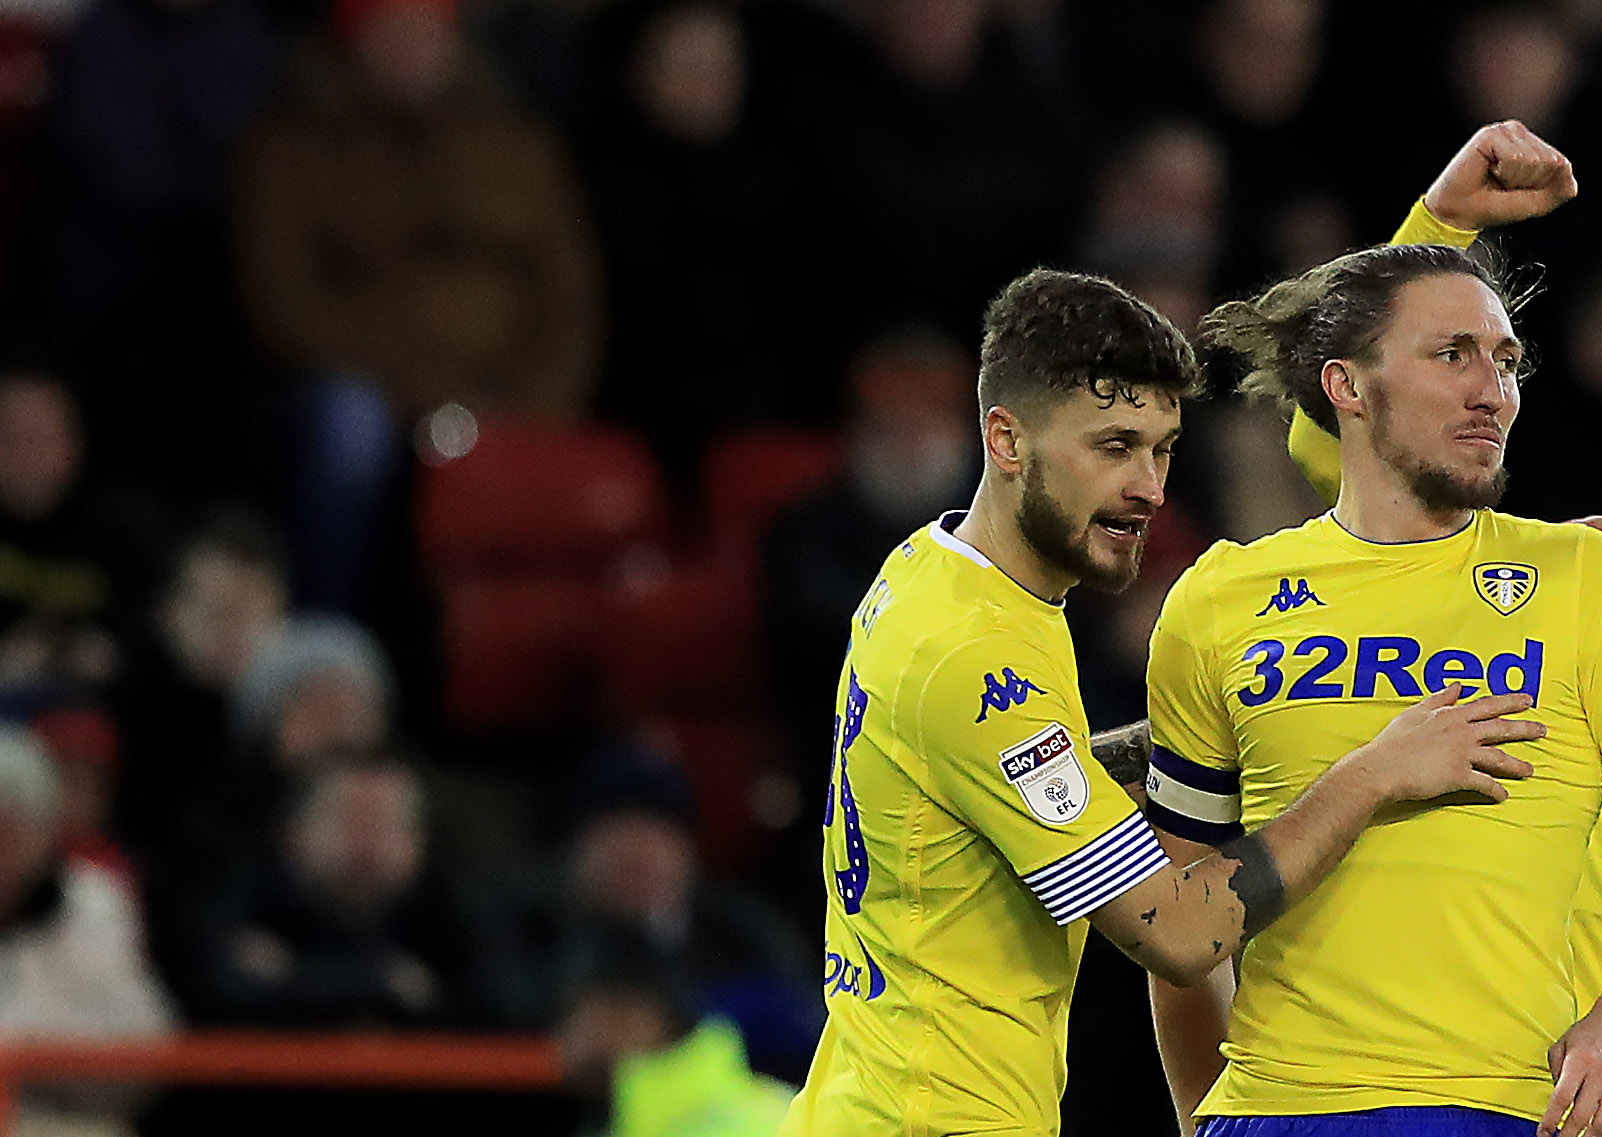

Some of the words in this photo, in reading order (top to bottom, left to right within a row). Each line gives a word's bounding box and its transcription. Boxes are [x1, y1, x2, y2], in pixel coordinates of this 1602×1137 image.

[1237, 635, 1544, 708] 32Red
[1007, 752, 1035, 775] sky
[1037, 734, 1068, 759] bet
[1056, 799, 1078, 815] EFL
